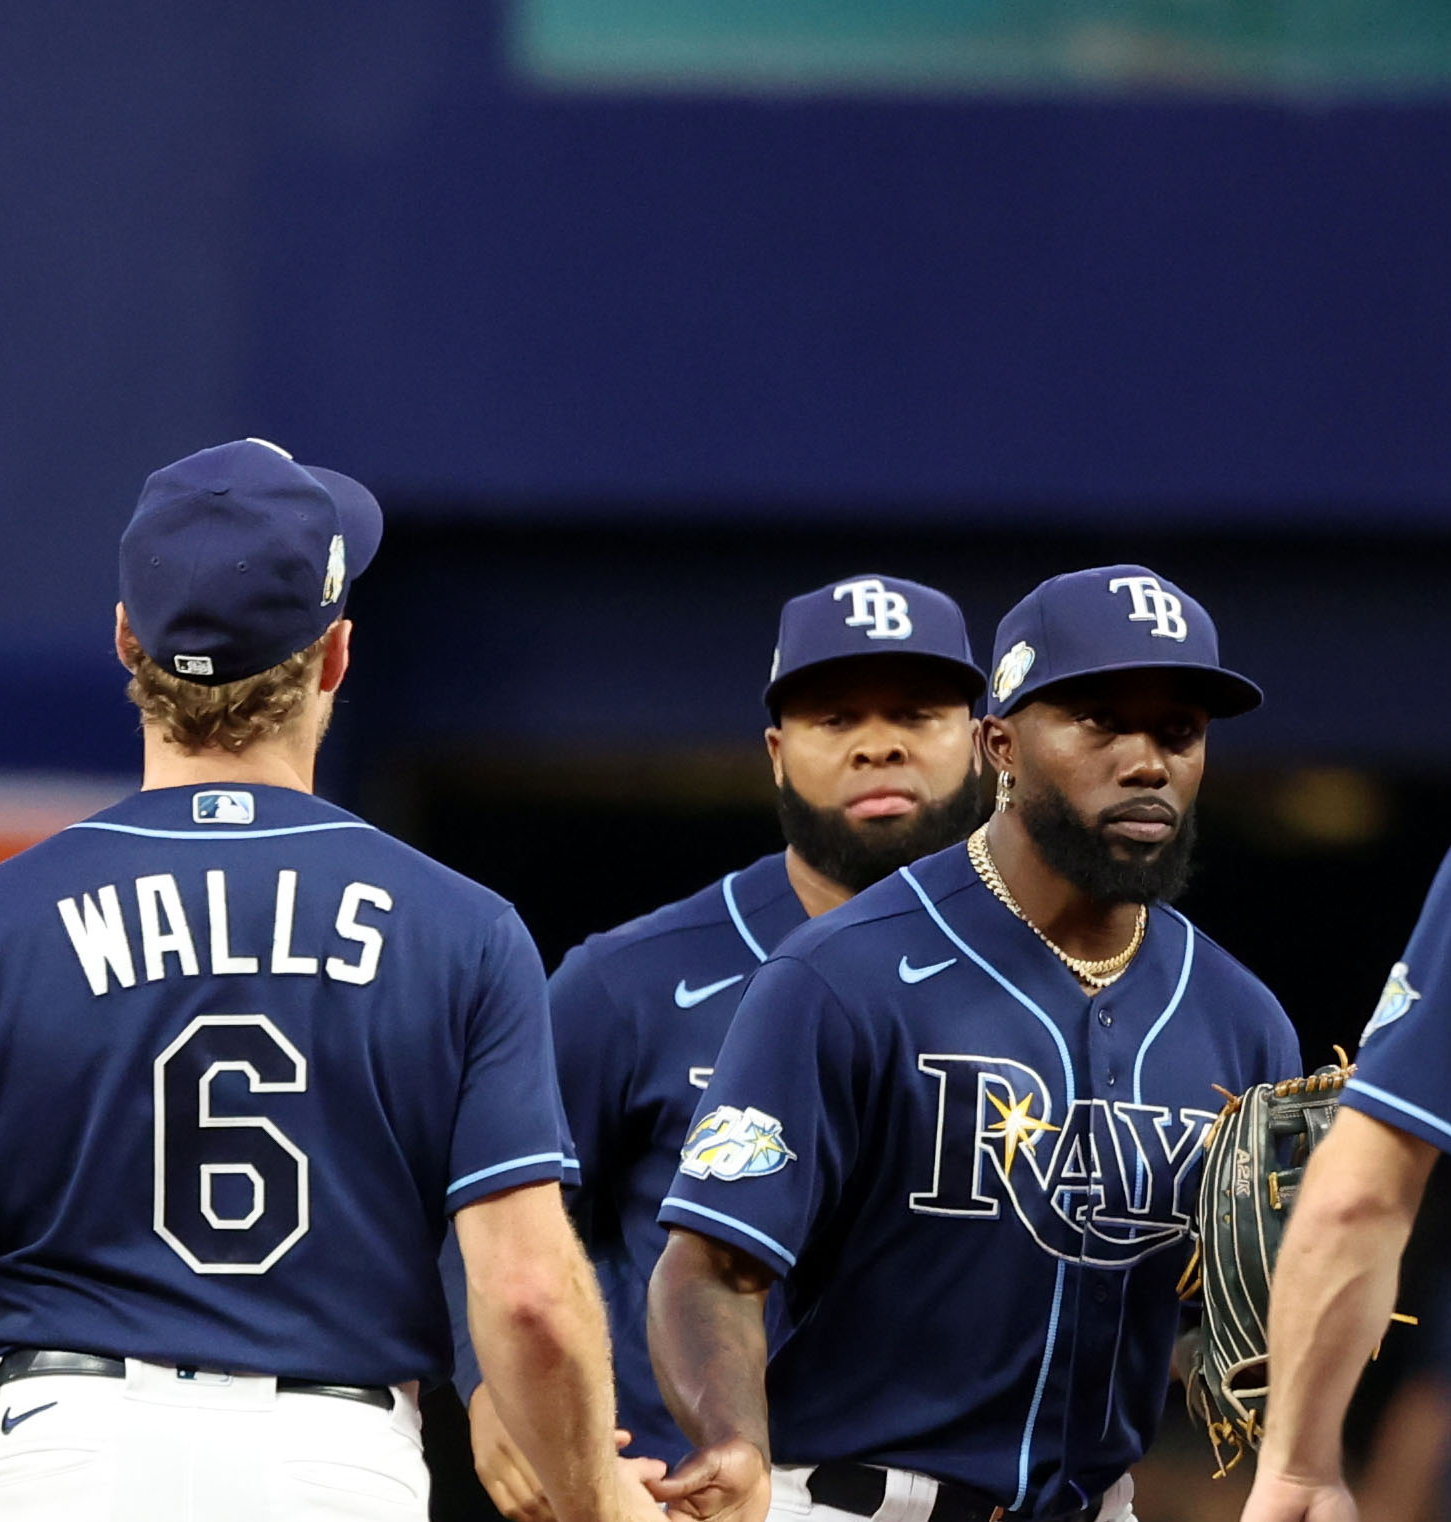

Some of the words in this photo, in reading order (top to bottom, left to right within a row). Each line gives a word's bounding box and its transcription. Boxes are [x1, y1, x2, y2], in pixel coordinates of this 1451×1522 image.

[833, 578, 913, 641] TB
[1109, 575, 1188, 642] TB
[57, 870, 393, 996] WALLS
[153, 1014, 310, 1275] 6
[908, 1054, 1212, 1267] RAY
[1235, 1147, 1252, 1198] A2K
